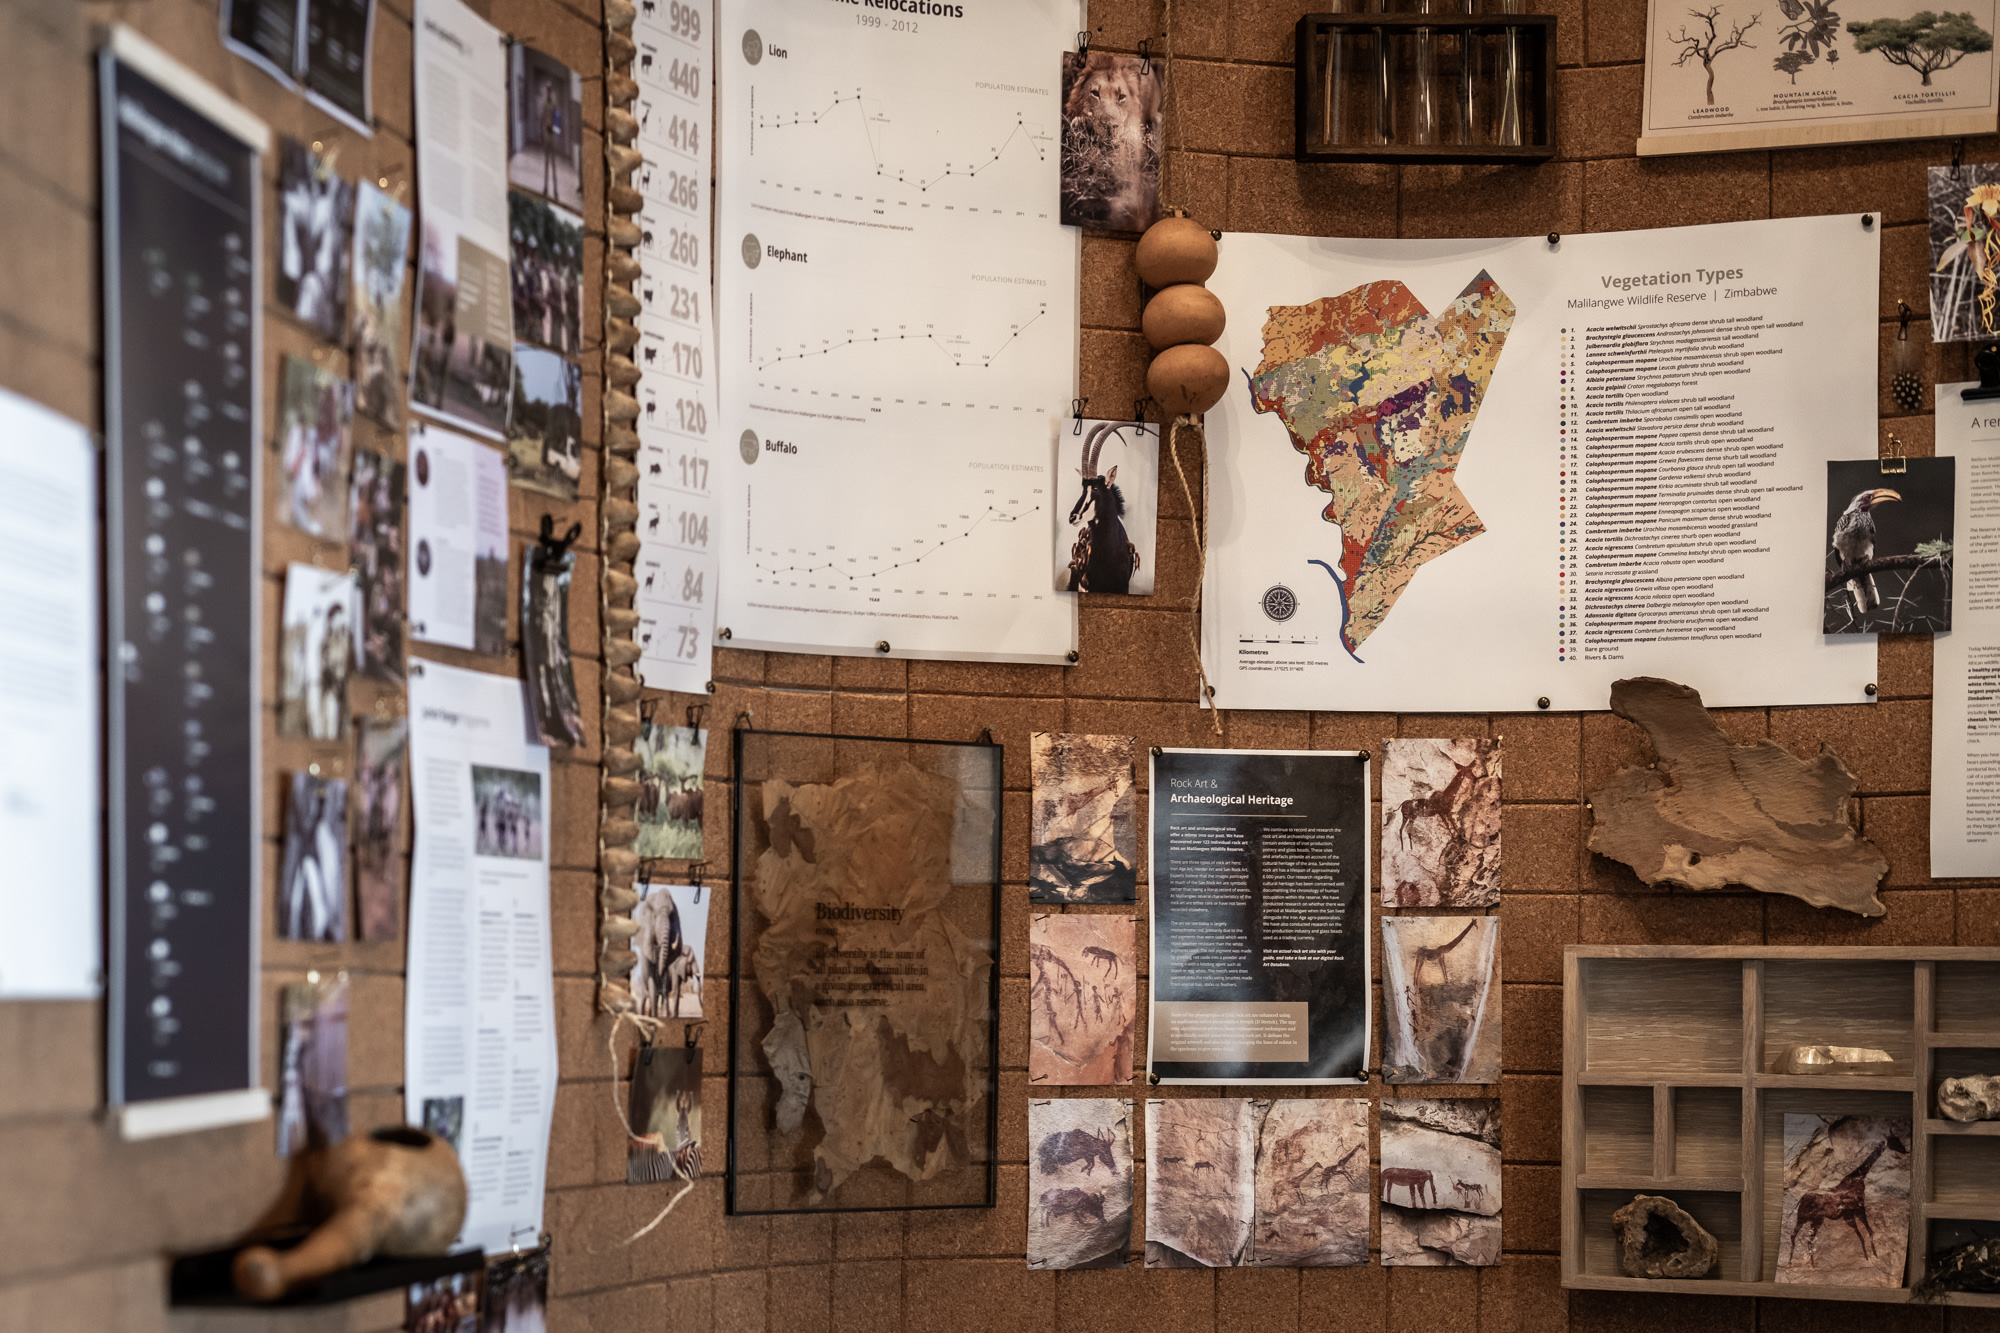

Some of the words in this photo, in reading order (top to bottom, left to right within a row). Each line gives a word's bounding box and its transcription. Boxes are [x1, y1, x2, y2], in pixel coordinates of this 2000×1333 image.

[669, 0, 701, 42] 999
[856, 13, 881, 28] 1999
[891, 19, 918, 34] 2012
[769, 43, 787, 59] Lion
[669, 57, 700, 99] 440
[975, 81, 1015, 92] POPULATION
[1016, 86, 1049, 96] ESTIMATES
[1773, 91, 1810, 99] MOUNTAIN
[1921, 90, 1956, 98] TORTILLIS
[1692, 106, 1730, 114] LEADWOOD
[668, 114, 699, 156] 414
[669, 170, 699, 212] 266
[669, 227, 699, 268] 260
[767, 245, 808, 263] Elephant
[971, 274, 1013, 284] POPULATION
[1014, 277, 1047, 287] ESTIMATES
[1601, 271, 1692, 291] Vegetation
[1695, 268, 1744, 285] Types
[669, 284, 700, 324] 231
[1567, 298, 1625, 310] Malilangwe
[1626, 294, 1664, 306] Wildlife
[1666, 291, 1707, 303] Reserve
[1723, 286, 1778, 299] Zimbabwe
[1736, 315, 1763, 323] woodland
[1585, 333, 1622, 341] Brachystegia
[1622, 332, 1656, 340] glaucescens
[672, 340, 703, 380] 170
[676, 397, 707, 436] 120
[1971, 417, 1981, 428] A
[1984, 418, 2000, 428] re
[765, 439, 798, 455] Buffalo
[678, 454, 709, 491] 117
[968, 462, 1010, 471] POPULATION
[1011, 464, 1044, 473] ESTIMATES
[1585, 510, 1633, 518] Colophospermum
[678, 510, 709, 548] 104
[681, 568, 704, 604] 84
[676, 624, 700, 661] 73
[1170, 778, 1193, 788] Rock
[1194, 779, 1208, 789] Art
[1210, 779, 1218, 789] &
[1170, 793, 1245, 807] Archaeological
[1248, 795, 1294, 807] Heritage
[816, 901, 905, 926] Biodiversity
[895, 950, 914, 960] sum
[916, 948, 926, 959] of
